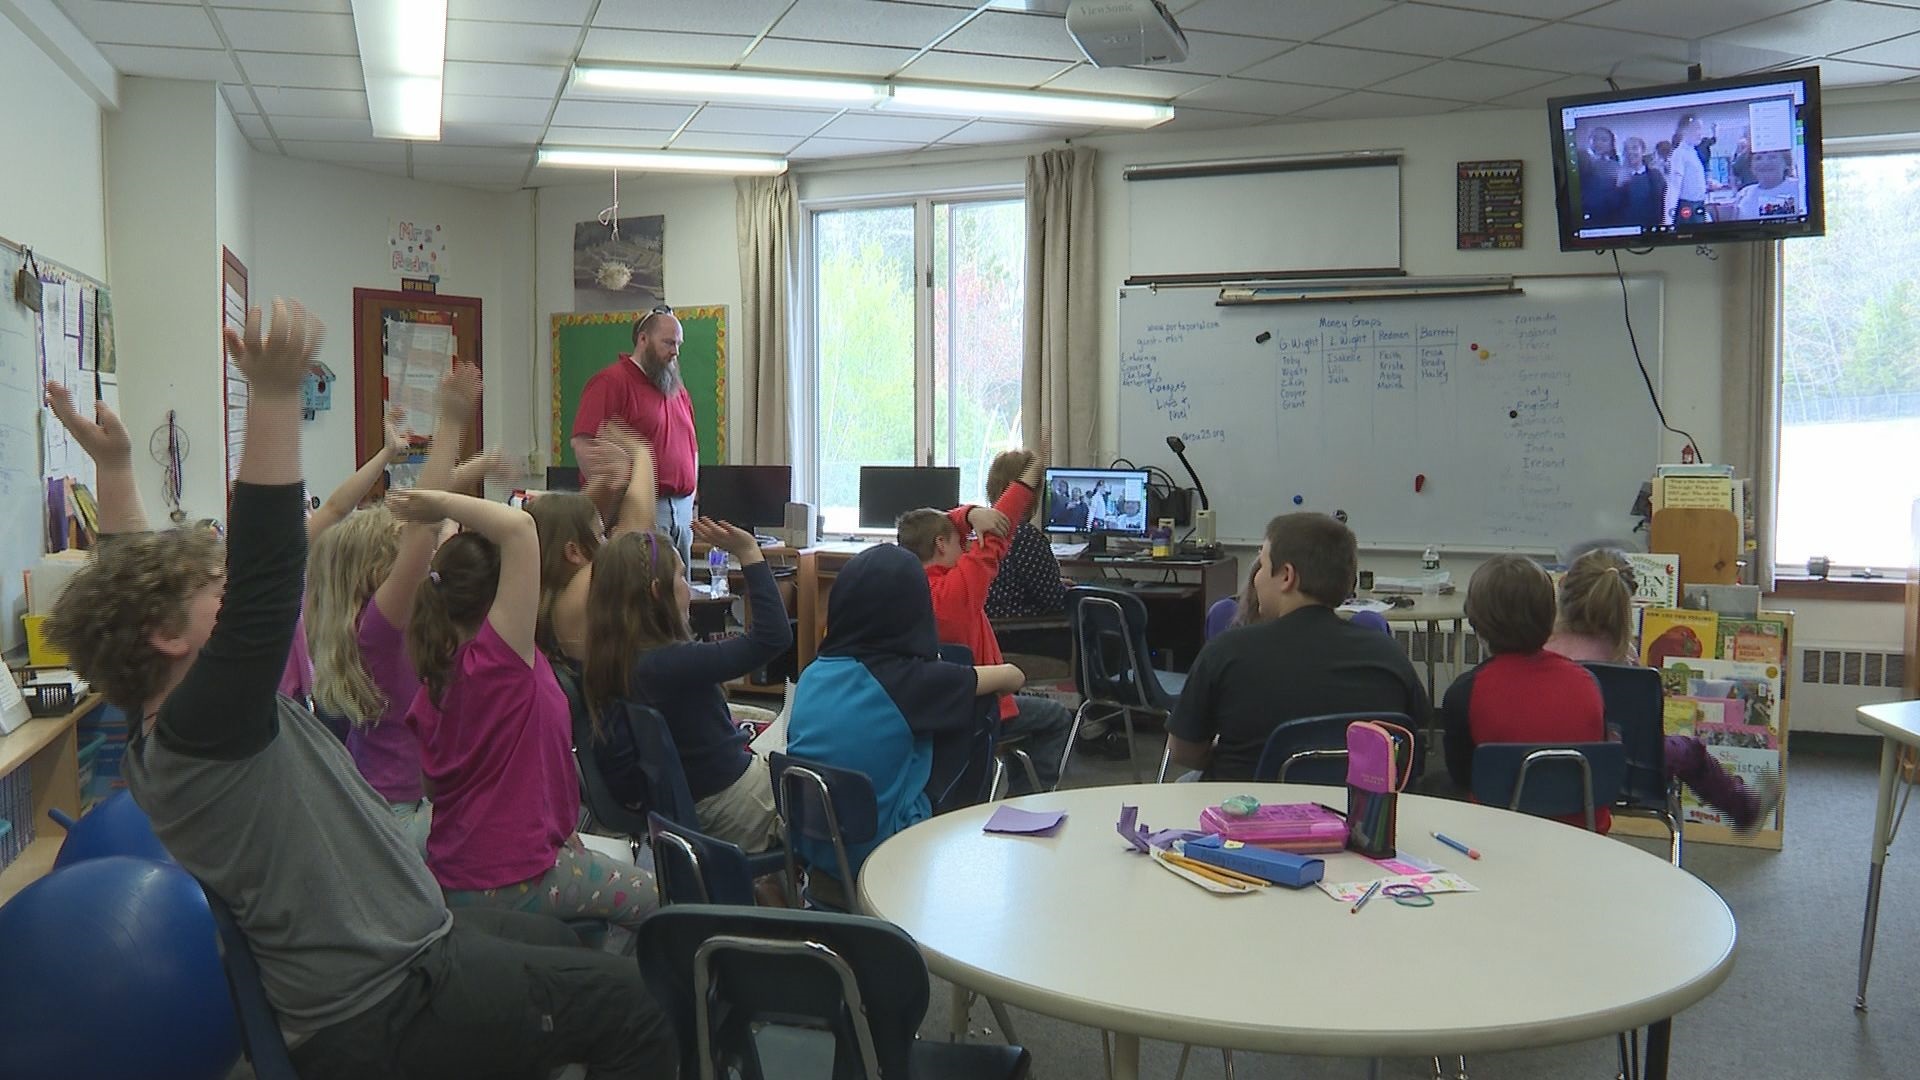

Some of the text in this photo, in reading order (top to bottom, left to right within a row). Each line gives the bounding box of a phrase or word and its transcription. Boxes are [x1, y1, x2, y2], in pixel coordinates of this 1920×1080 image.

[1080, 3, 1134, 16] ViewSonic
[1319, 315, 1382, 334] Money Groups
[1280, 389, 1307, 400] Cooper
[1282, 400, 1305, 410] Grant
